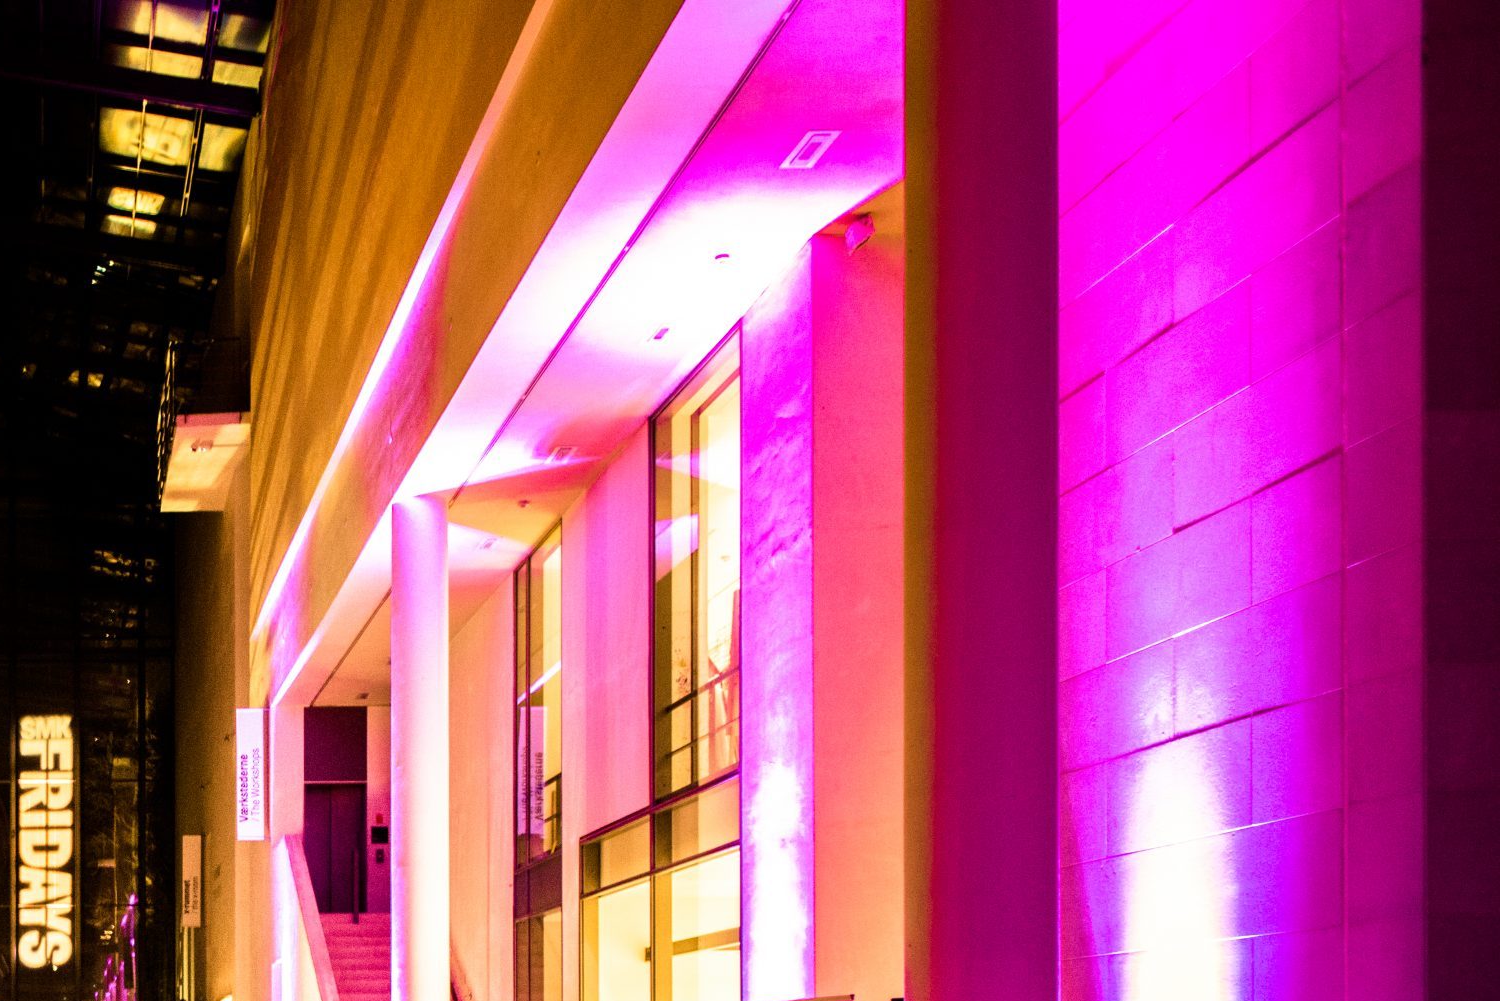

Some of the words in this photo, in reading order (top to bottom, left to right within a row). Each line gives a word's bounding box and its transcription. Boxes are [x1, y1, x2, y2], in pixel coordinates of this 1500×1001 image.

[19, 715, 72, 740] SMK
[239, 754, 249, 822] Værkstederne
[251, 748, 262, 798] Workshops
[251, 799, 260, 815] The
[18, 738, 74, 969] FRIDAYS
